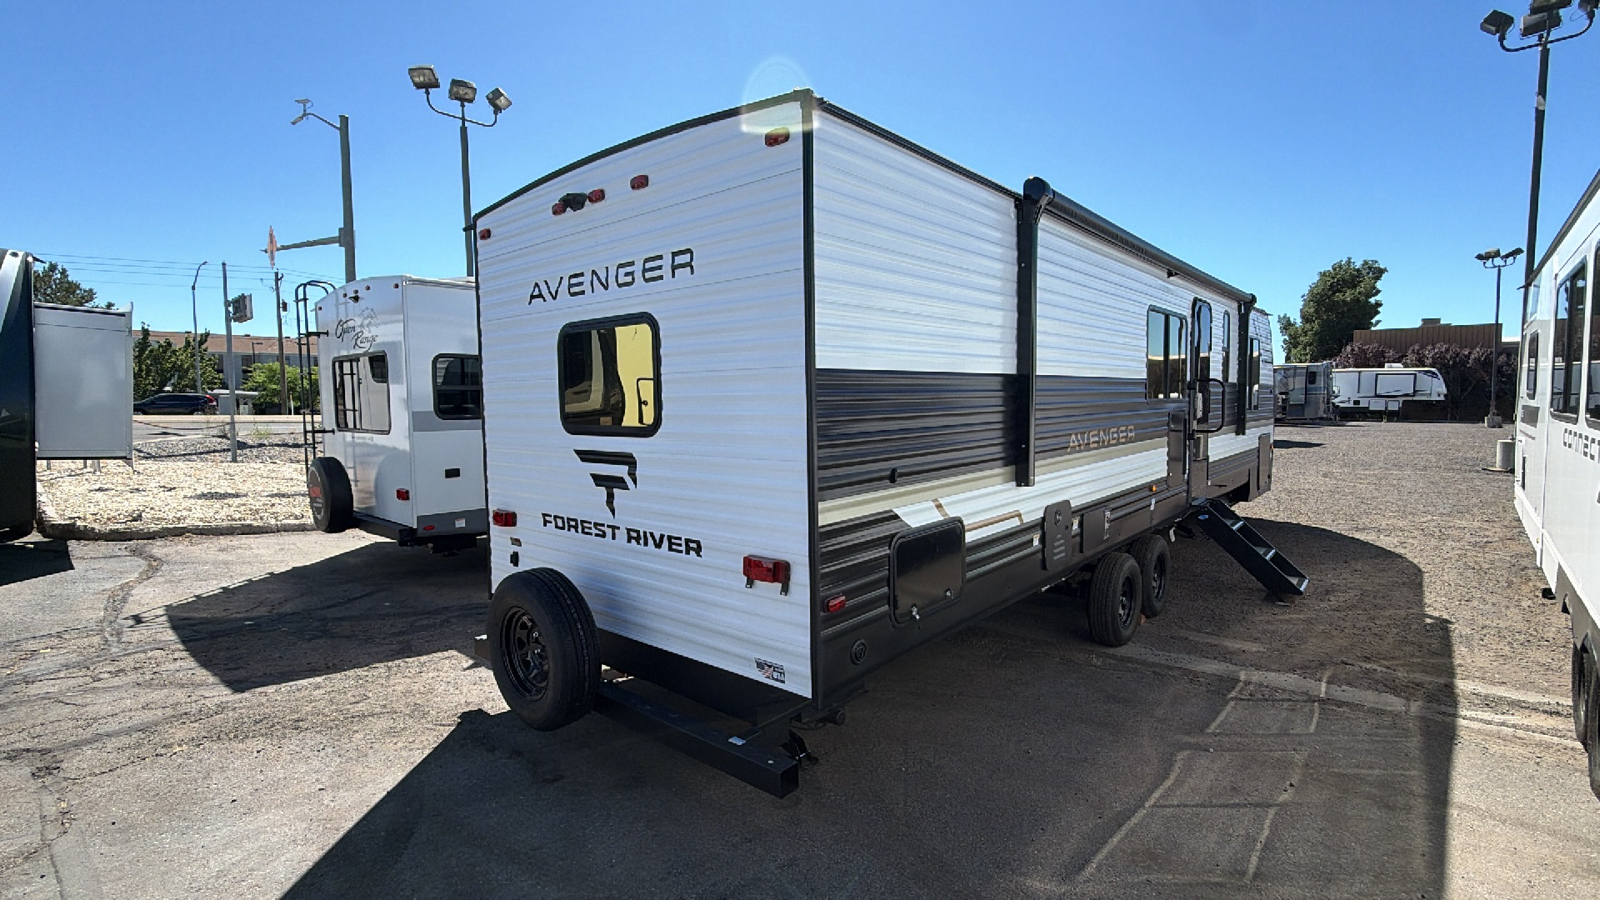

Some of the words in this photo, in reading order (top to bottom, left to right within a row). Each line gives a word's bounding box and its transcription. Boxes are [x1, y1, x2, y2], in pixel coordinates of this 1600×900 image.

[528, 248, 694, 305] AVENGER
[335, 318, 356, 343] Open
[350, 329, 379, 353] Range
[1067, 425, 1135, 452] AVENGER
[541, 512, 620, 541] FOREST
[625, 526, 703, 558] RIVER
